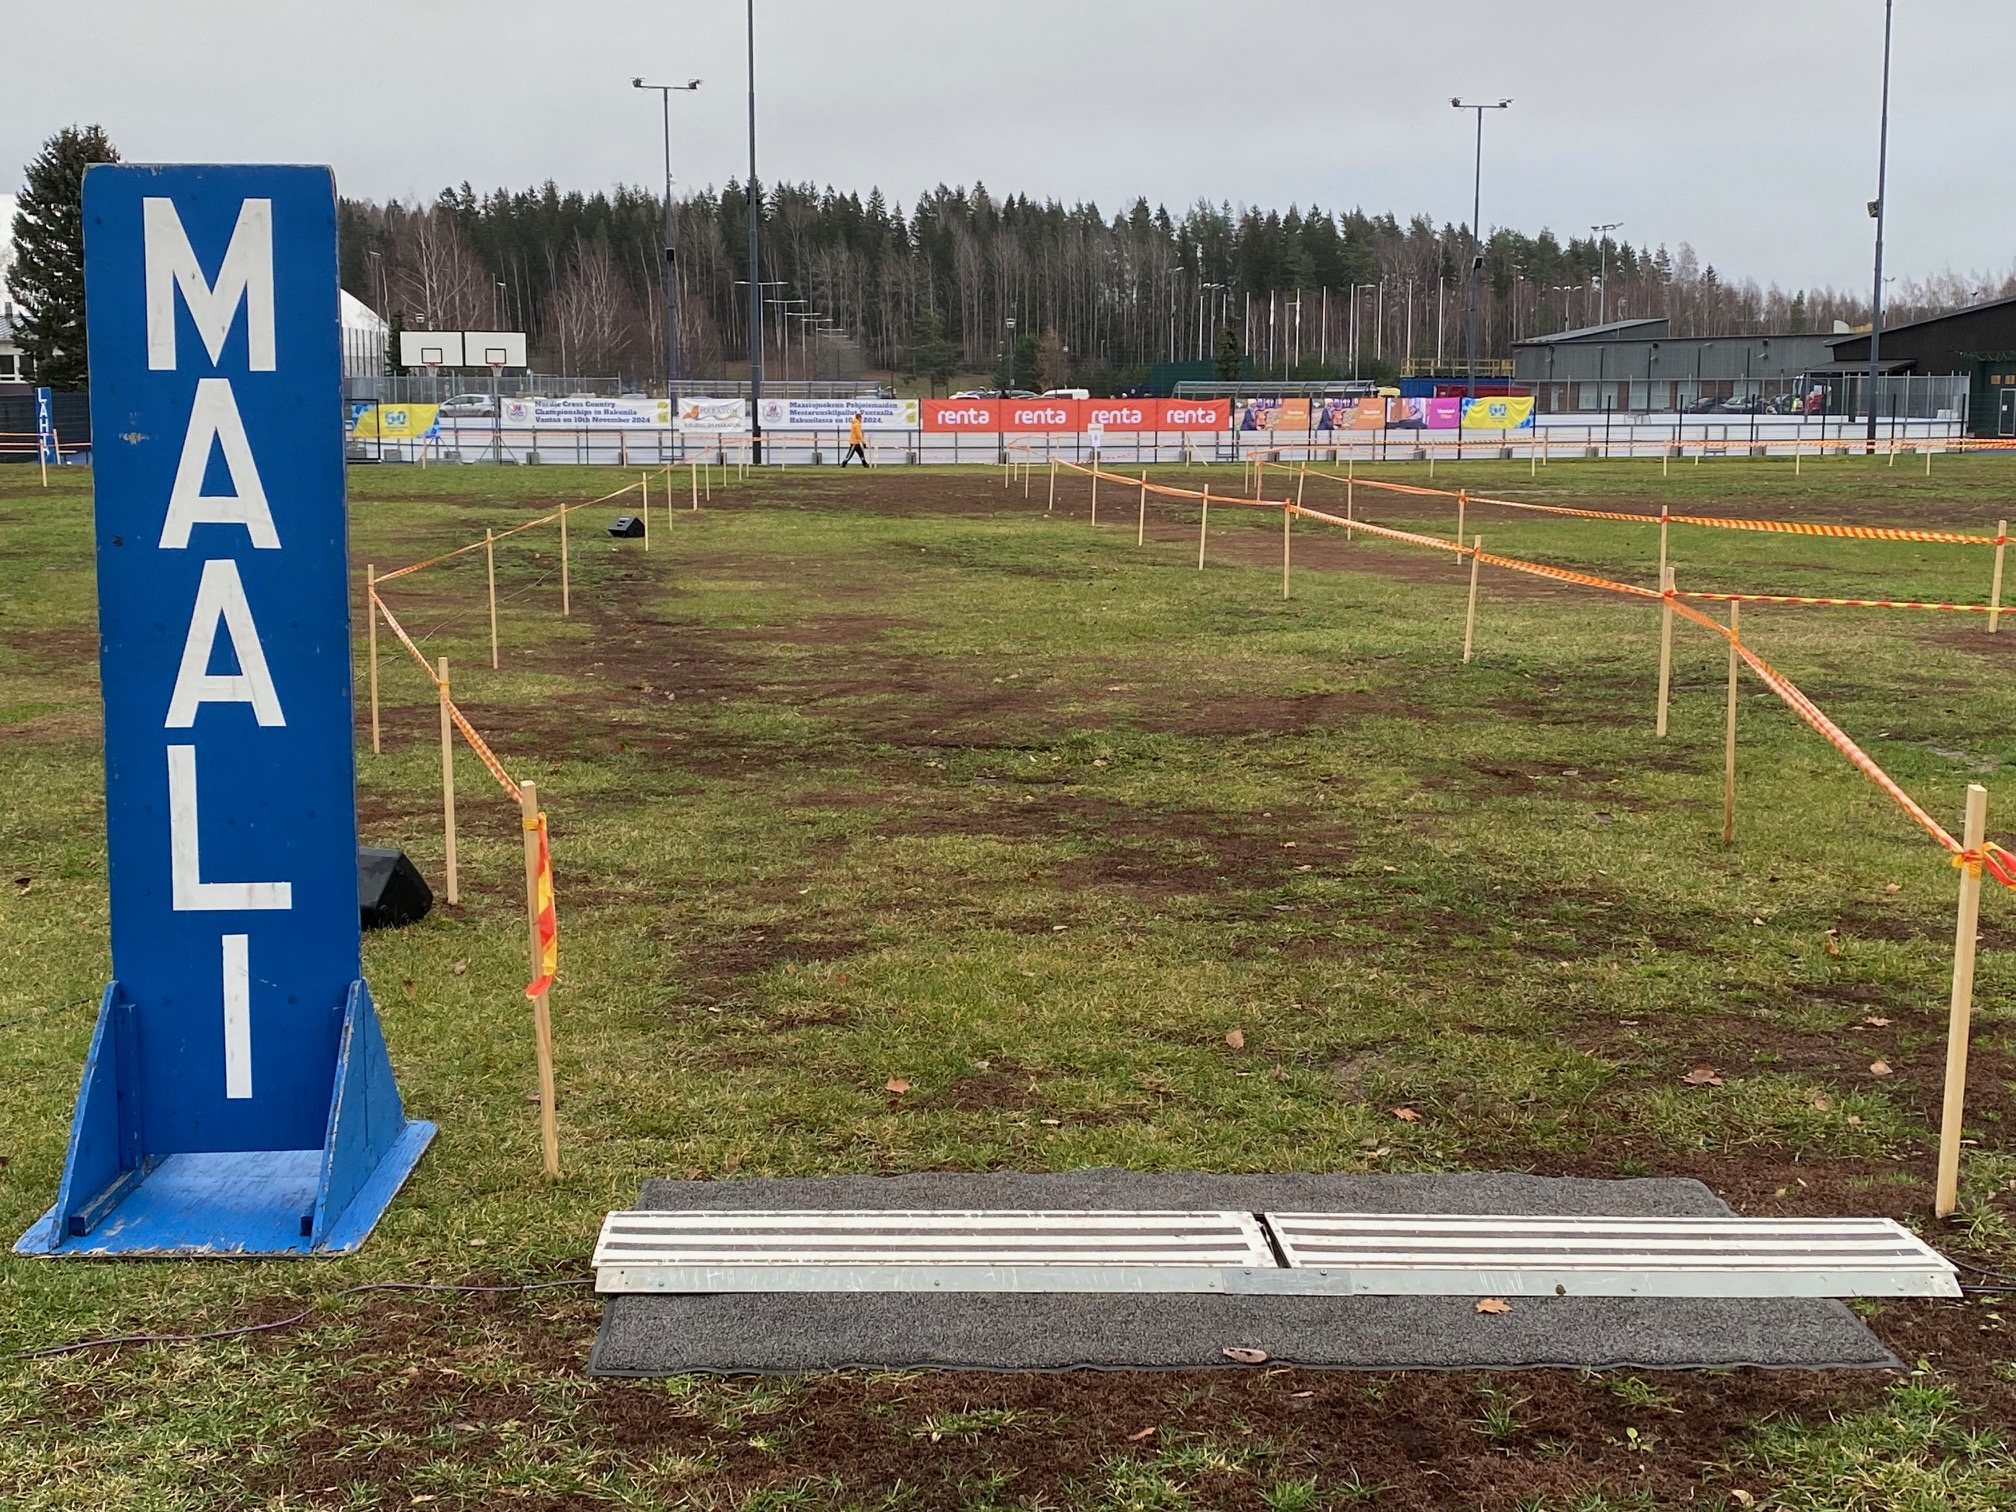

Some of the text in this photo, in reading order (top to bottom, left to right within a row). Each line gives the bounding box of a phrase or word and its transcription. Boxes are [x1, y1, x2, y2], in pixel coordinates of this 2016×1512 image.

[535, 408, 592, 416] Championships
[603, 408, 638, 416] Hakunila
[585, 401, 616, 409] Country
[789, 409, 858, 417] Mestaruuskilpailut
[846, 402, 898, 410] Pohjoismaiden
[37, 387, 50, 456] LAHT
[592, 416, 630, 424] November
[631, 416, 651, 424] 2024
[937, 407, 990, 425] renta
[1014, 407, 1067, 425] renta
[1091, 407, 1142, 424] renta
[1166, 407, 1217, 424] renta
[142, 197, 292, 1099] MAALI
